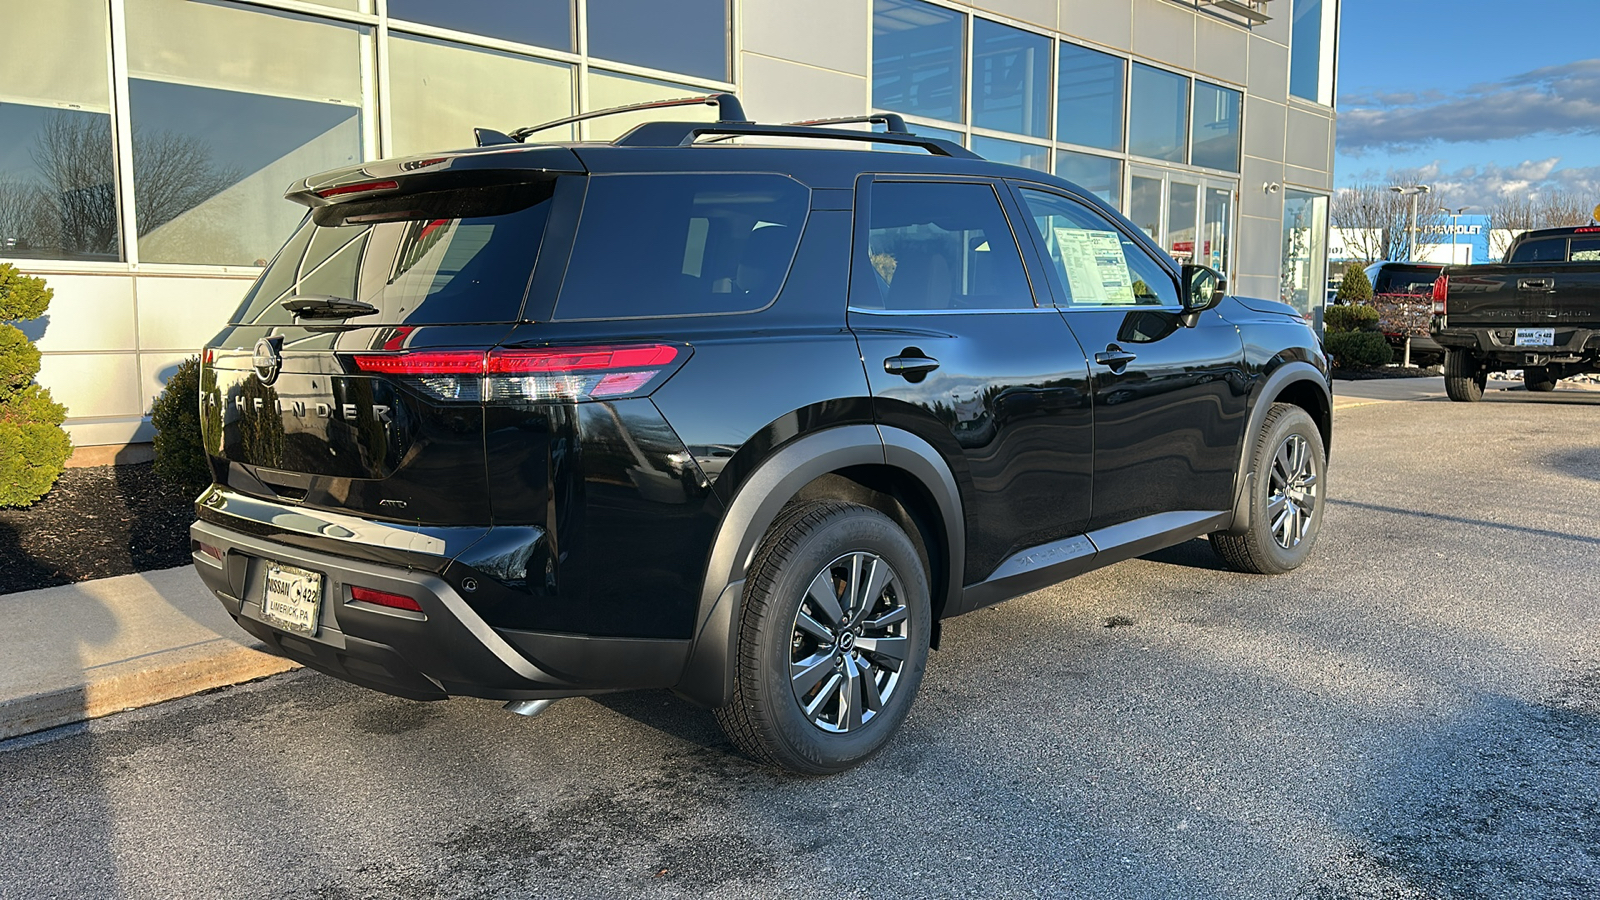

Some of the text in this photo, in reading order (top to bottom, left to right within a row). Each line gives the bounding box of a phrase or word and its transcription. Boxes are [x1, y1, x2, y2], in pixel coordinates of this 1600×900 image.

[1424, 225, 1482, 235] CHEVROLET
[253, 357, 275, 366] SSAN
[200, 391, 391, 422] PATHFINDER
[269, 578, 317, 603] NISSAN 422
[300, 609, 309, 621] PA
